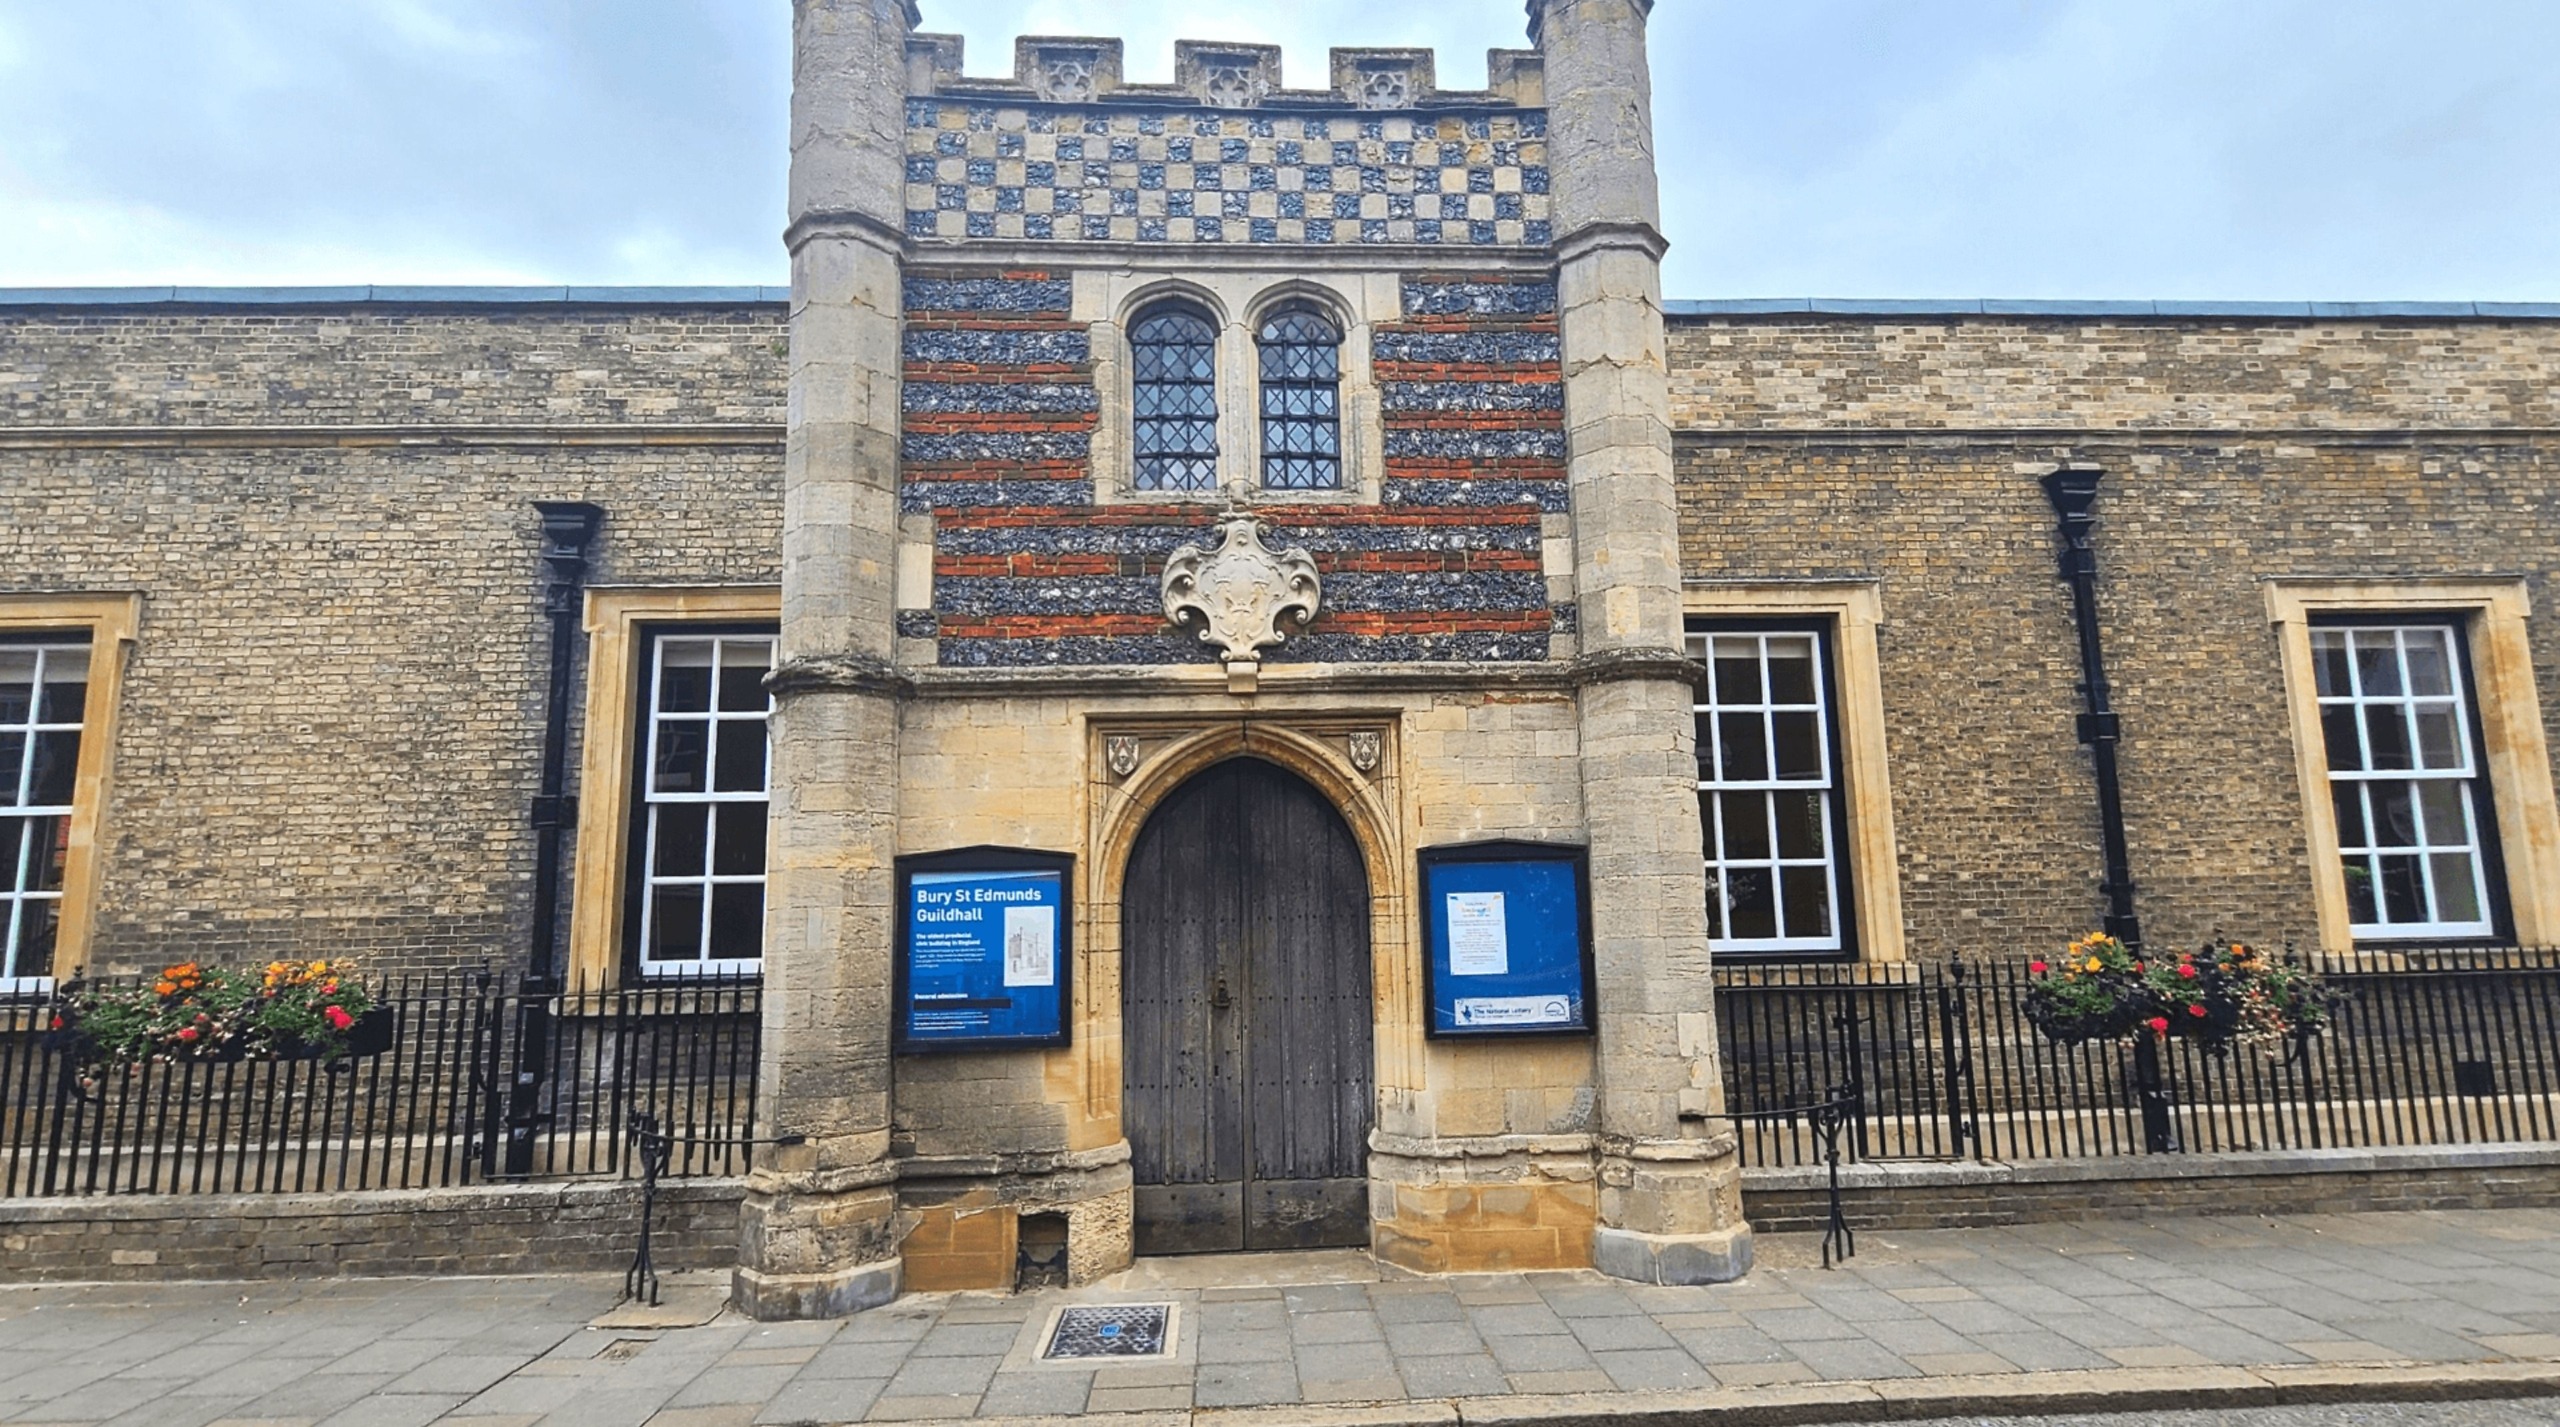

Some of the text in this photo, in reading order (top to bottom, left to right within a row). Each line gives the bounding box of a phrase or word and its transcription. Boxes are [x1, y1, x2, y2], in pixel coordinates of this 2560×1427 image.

[917, 888, 1042, 906] Bury St Edmunds
[917, 908, 983, 922] Guildhall
